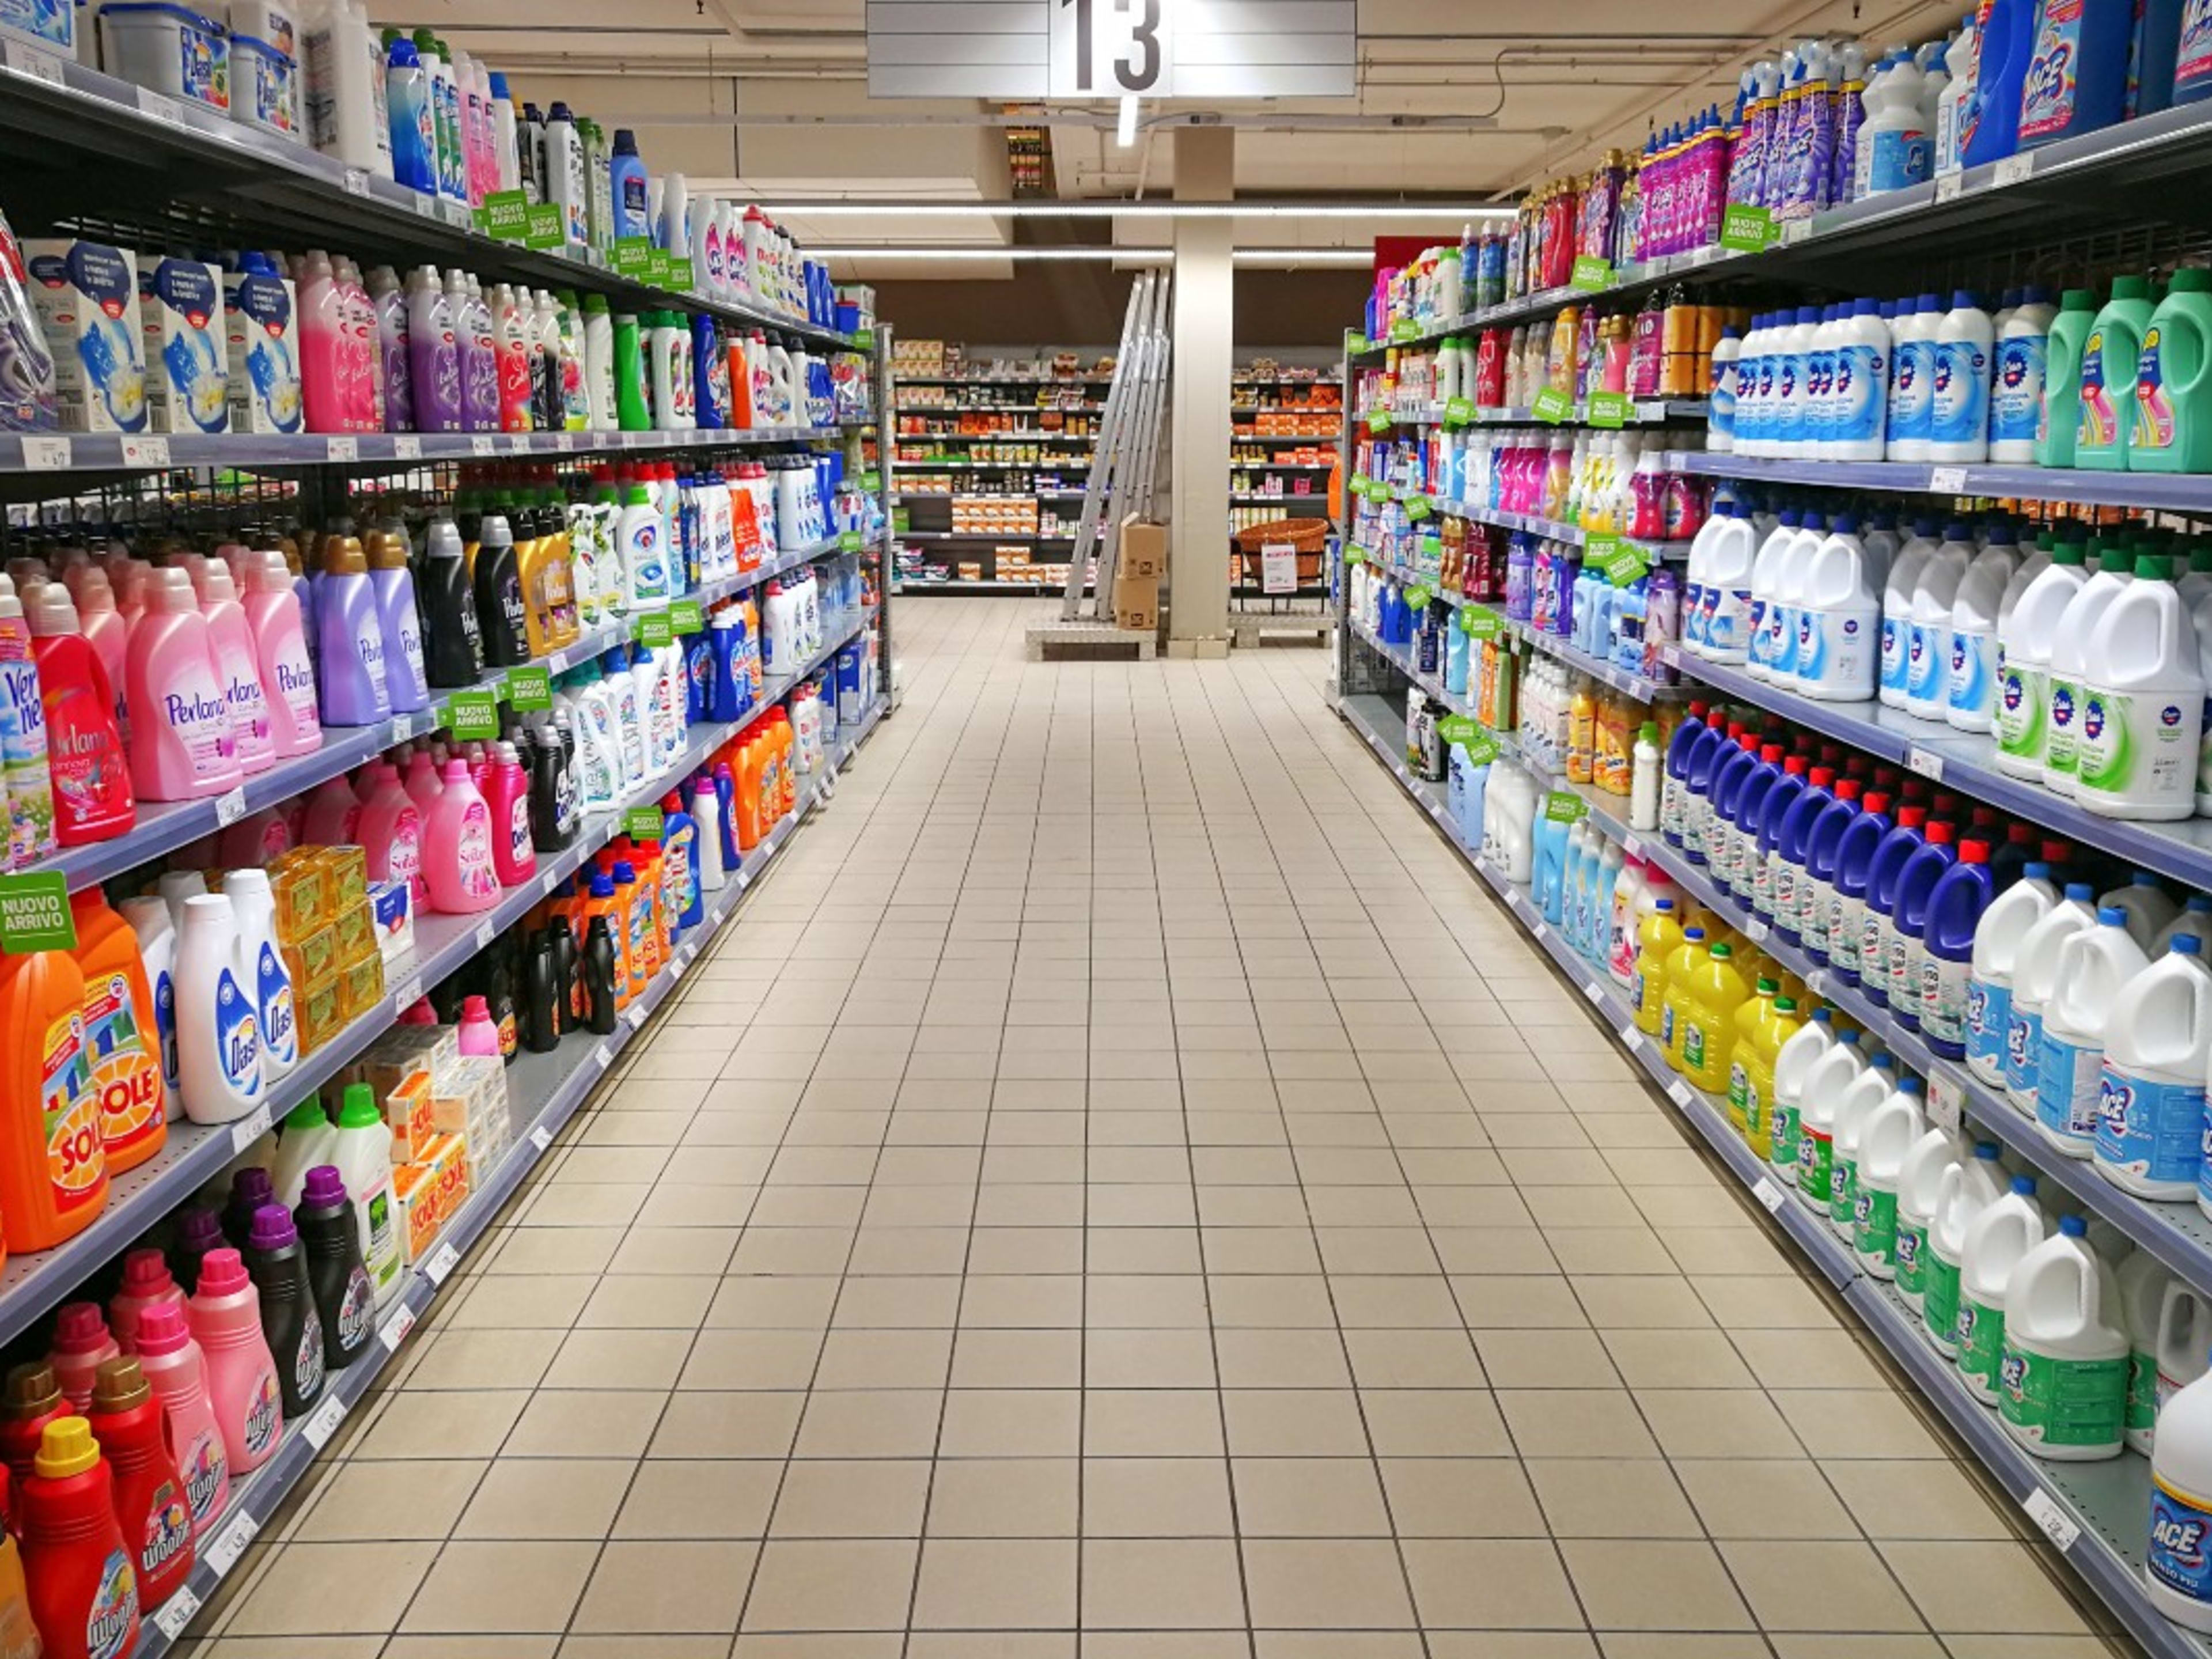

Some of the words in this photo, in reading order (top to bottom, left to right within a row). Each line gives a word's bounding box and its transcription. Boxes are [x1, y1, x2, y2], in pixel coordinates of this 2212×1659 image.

[1062, 0, 1160, 91] 13
[5, 667, 37, 708] Ver
[454, 704, 491, 716] NUOVO
[456, 713, 493, 726] ARRIVO
[2, 895, 59, 915] NUOVO
[5, 912, 64, 931] ARRIVO
[96, 1070, 153, 1115] OLE
[2099, 1094, 2126, 1120] ACE
[2153, 1518, 2200, 1554] ACE
